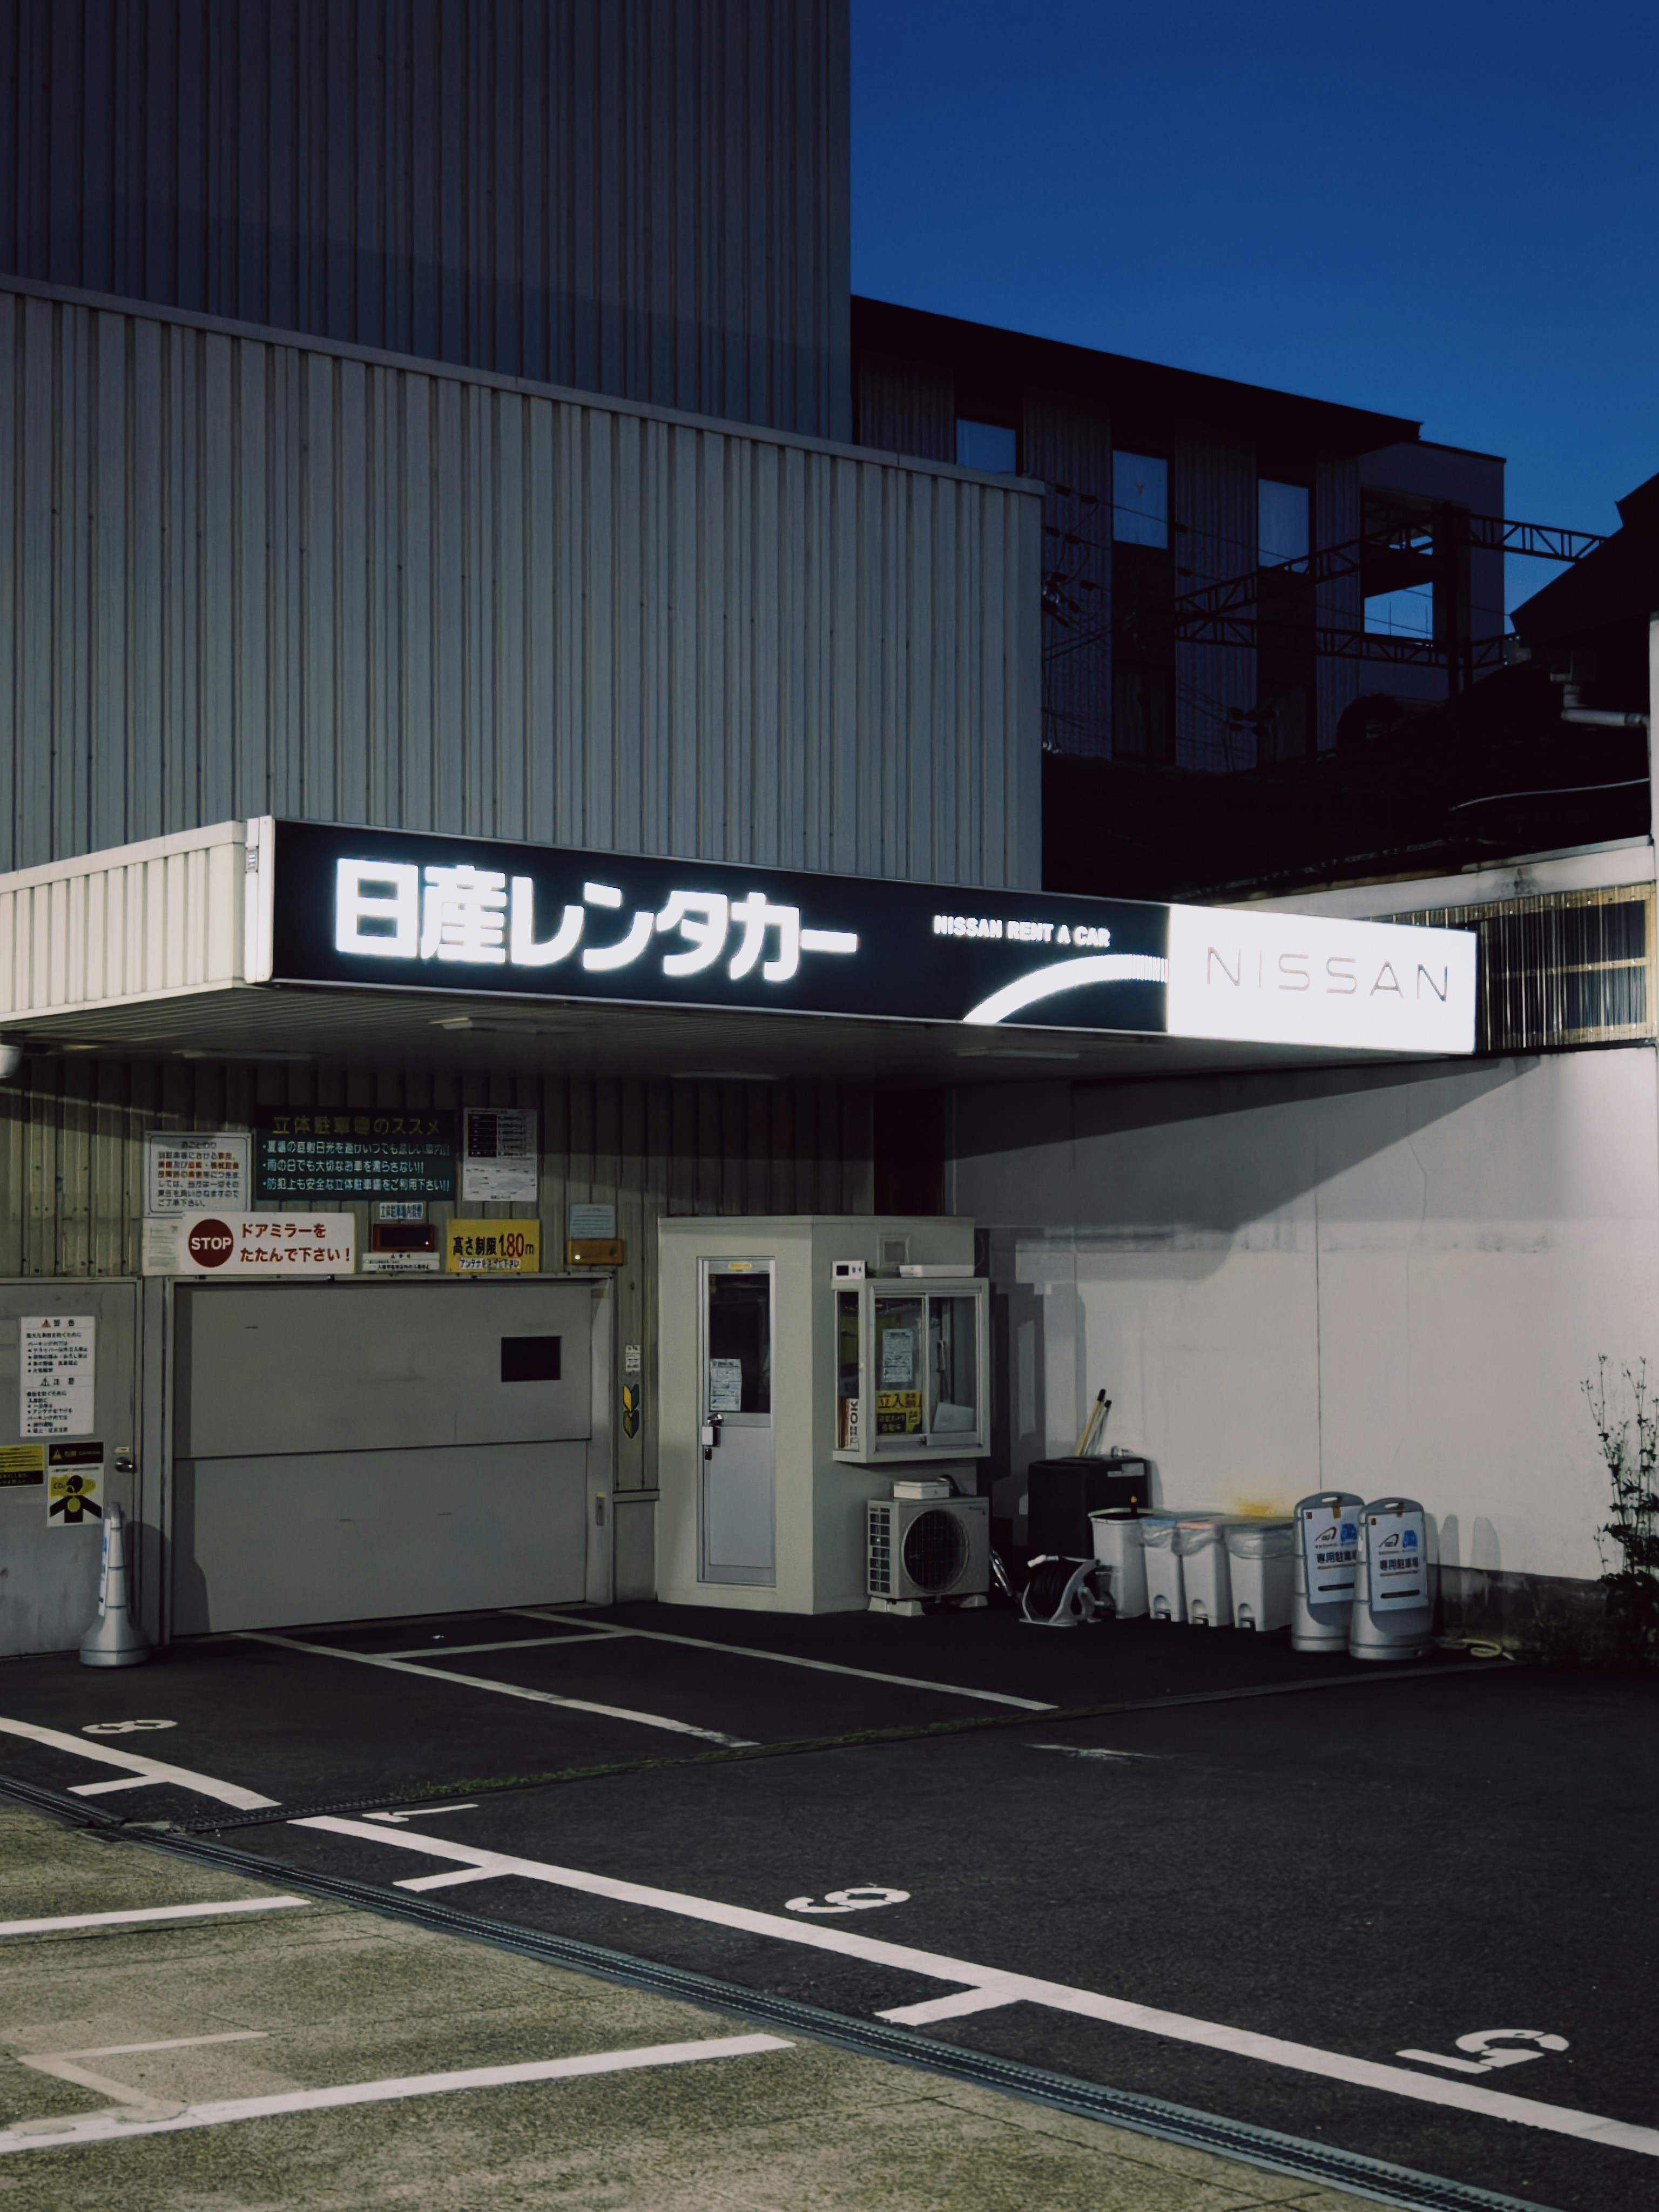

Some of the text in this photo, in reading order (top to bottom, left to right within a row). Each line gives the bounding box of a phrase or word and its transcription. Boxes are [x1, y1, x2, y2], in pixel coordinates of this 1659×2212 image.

[335, 858, 859, 982] 日産レンタカー
[934, 914, 1110, 947] NISSAN RENT A CAR
[1207, 946, 1447, 1002] NISSAN
[272, 1116, 440, 1136] 立体駐車場のススメ
[242, 1223, 326, 1238] ドアミラーを
[191, 1237, 232, 1251] STOP
[82, 1718, 179, 1735] 8
[1394, 2028, 1570, 2074] 5
